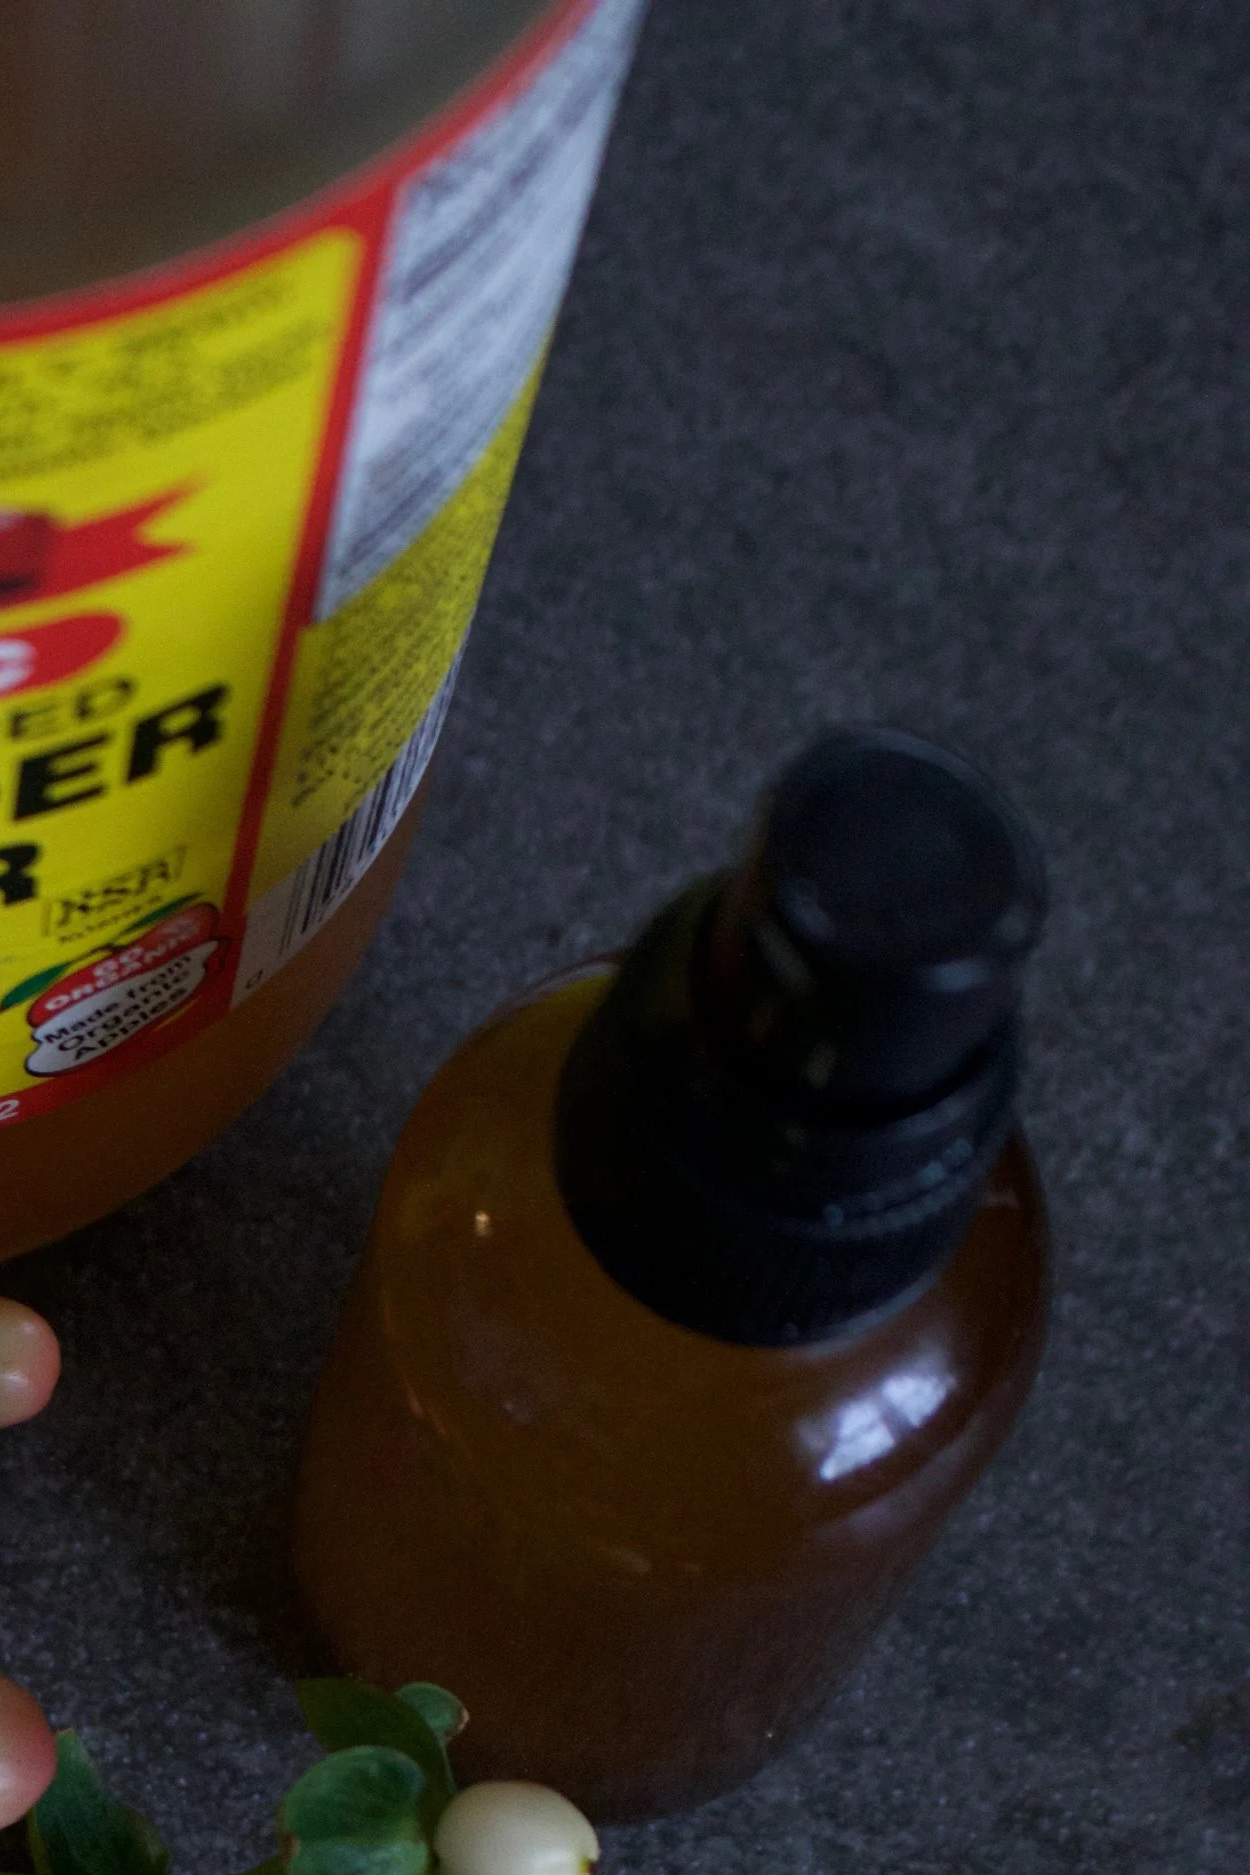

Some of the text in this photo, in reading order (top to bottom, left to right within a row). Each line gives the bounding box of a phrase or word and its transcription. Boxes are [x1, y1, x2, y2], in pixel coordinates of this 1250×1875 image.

[46, 956, 192, 1043] Made from
[57, 970, 191, 1051] Organic
[75, 988, 188, 1060] Apples
